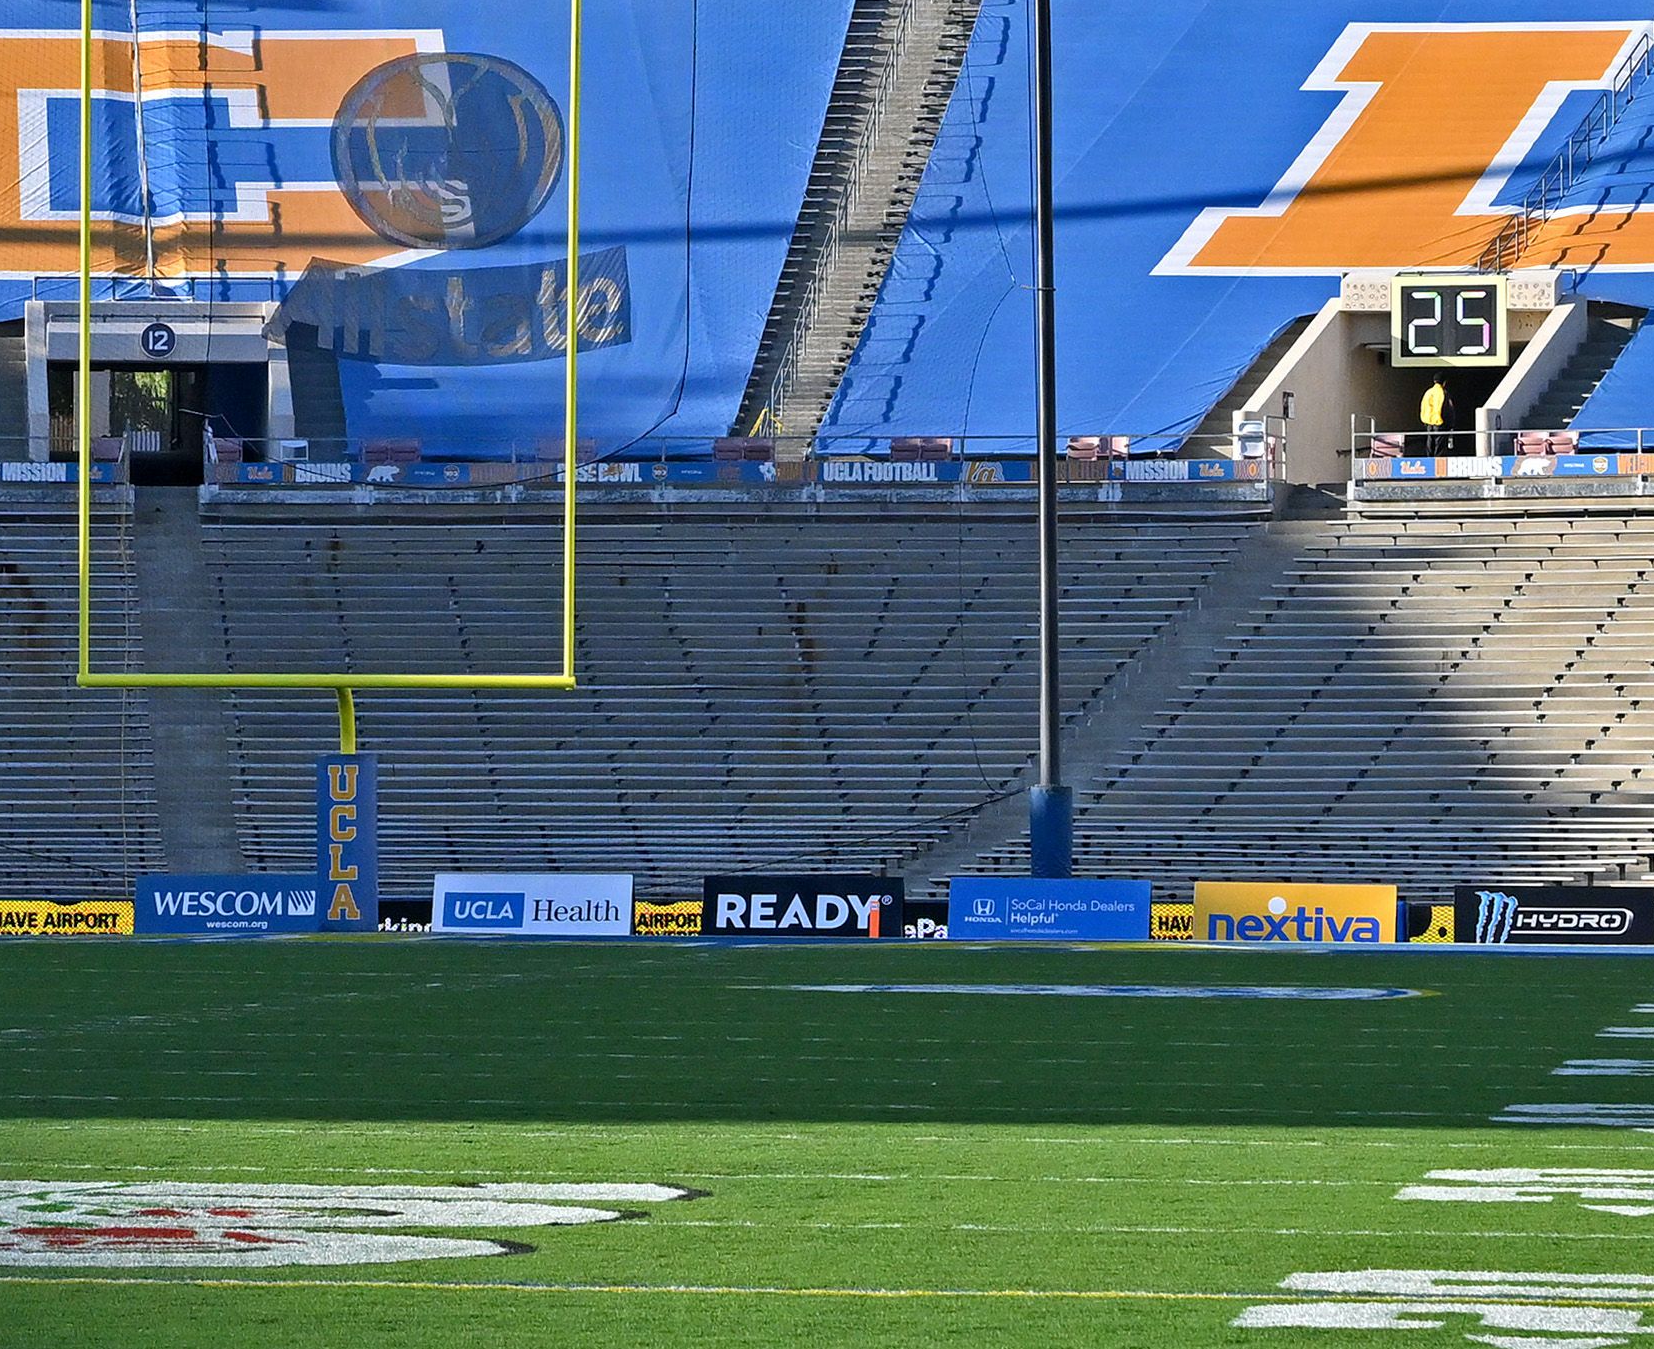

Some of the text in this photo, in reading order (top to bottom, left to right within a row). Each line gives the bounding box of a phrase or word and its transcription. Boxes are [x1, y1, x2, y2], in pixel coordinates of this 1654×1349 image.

[1408, 291, 1490, 354] 25
[148, 331, 168, 350] 12
[2, 463, 66, 482] MISSION
[295, 463, 351, 483] BRUINS
[823, 462, 862, 481] UCLA
[863, 462, 938, 481] FOOTBALL
[1126, 461, 1188, 480] MISSION
[1448, 457, 1502, 476] BRUINS
[327, 765, 360, 920] UCLA
[153, 890, 282, 916] WESCOM
[454, 898, 620, 922] UCLA Health
[716, 893, 881, 929] READY
[1011, 899, 1135, 912] SoCal Honda Dealers
[43, 912, 122, 929] AIRPORT
[206, 919, 268, 930] wescom.org
[1158, 916, 1193, 931] HAV
[1209, 905, 1380, 942] nextiva
[1517, 913, 1622, 928] HYDRO
